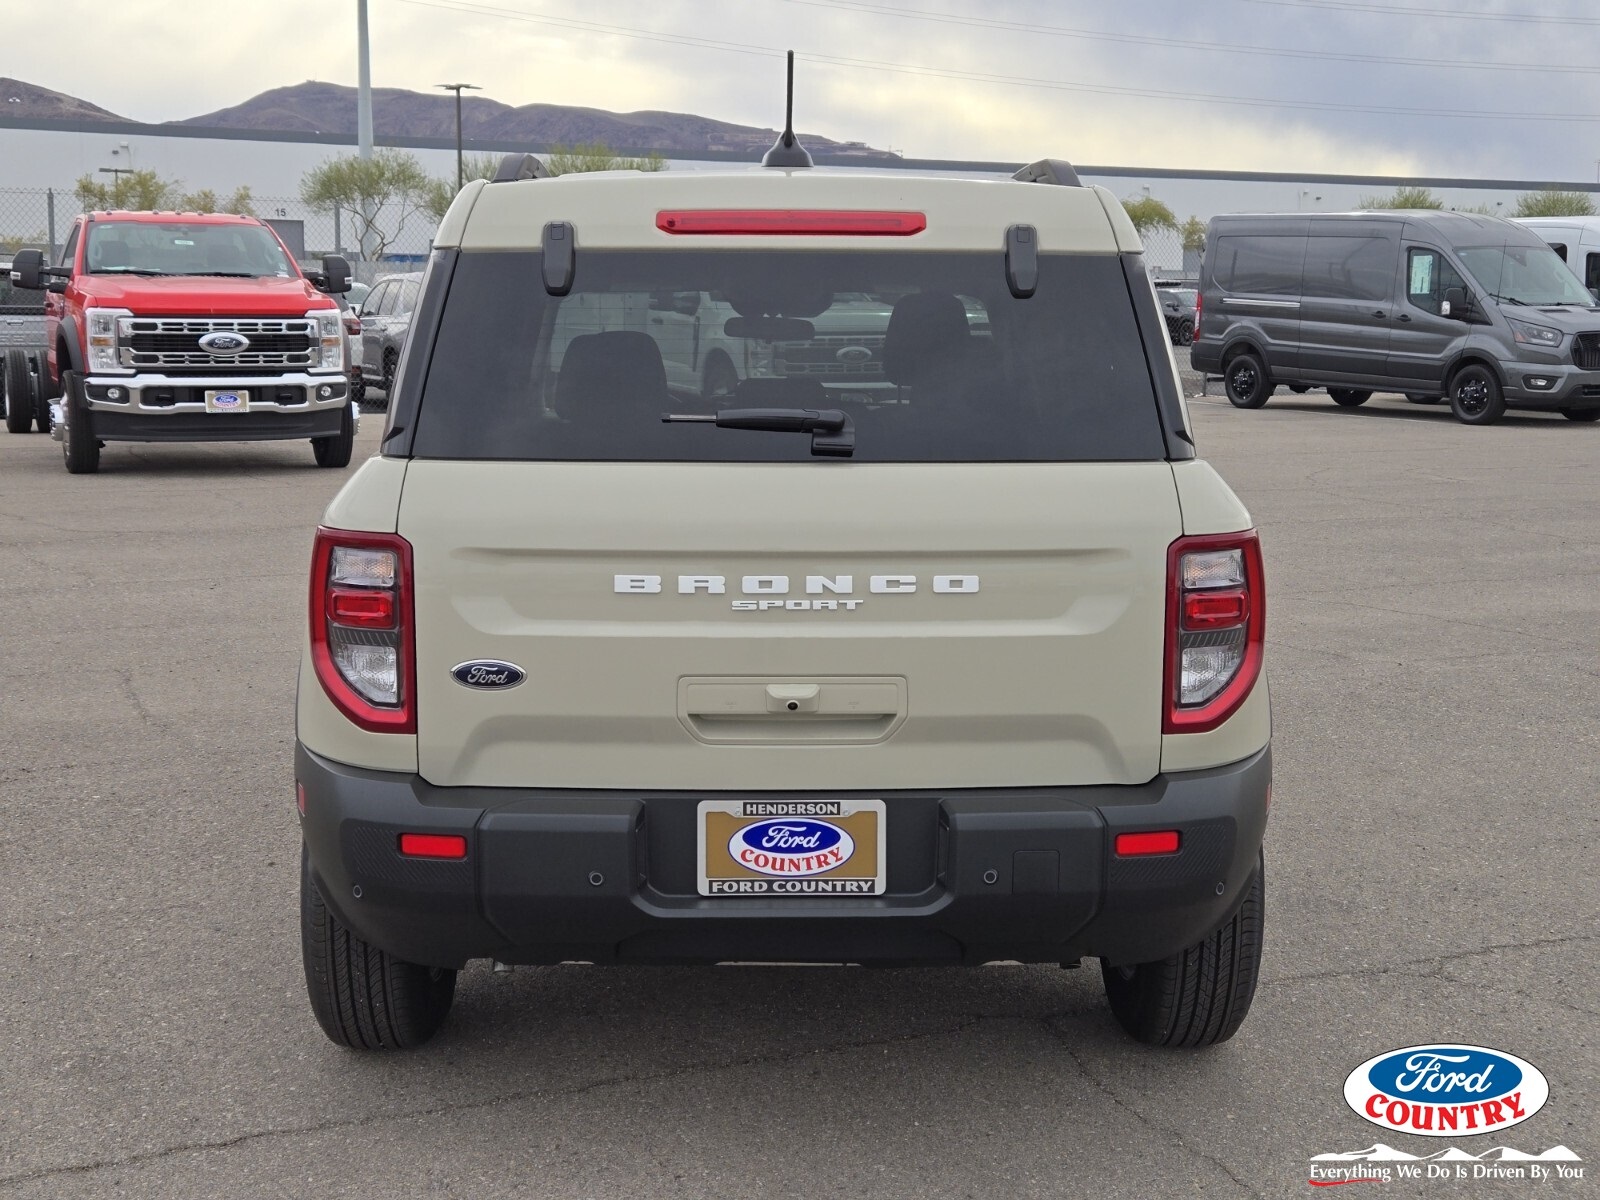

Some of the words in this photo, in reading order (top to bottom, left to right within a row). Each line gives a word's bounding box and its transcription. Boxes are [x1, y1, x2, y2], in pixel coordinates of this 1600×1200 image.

[275, 208, 286, 217] 15
[212, 337, 236, 348] Ford
[614, 574, 980, 594] BRONCO
[731, 600, 864, 610] SPORT
[467, 665, 508, 684] Ford
[745, 803, 838, 815] HENDERSON
[762, 825, 821, 848] Ford
[740, 846, 843, 872] COUNTRY
[712, 881, 768, 892] FORD
[772, 881, 873, 892] COUNTRY
